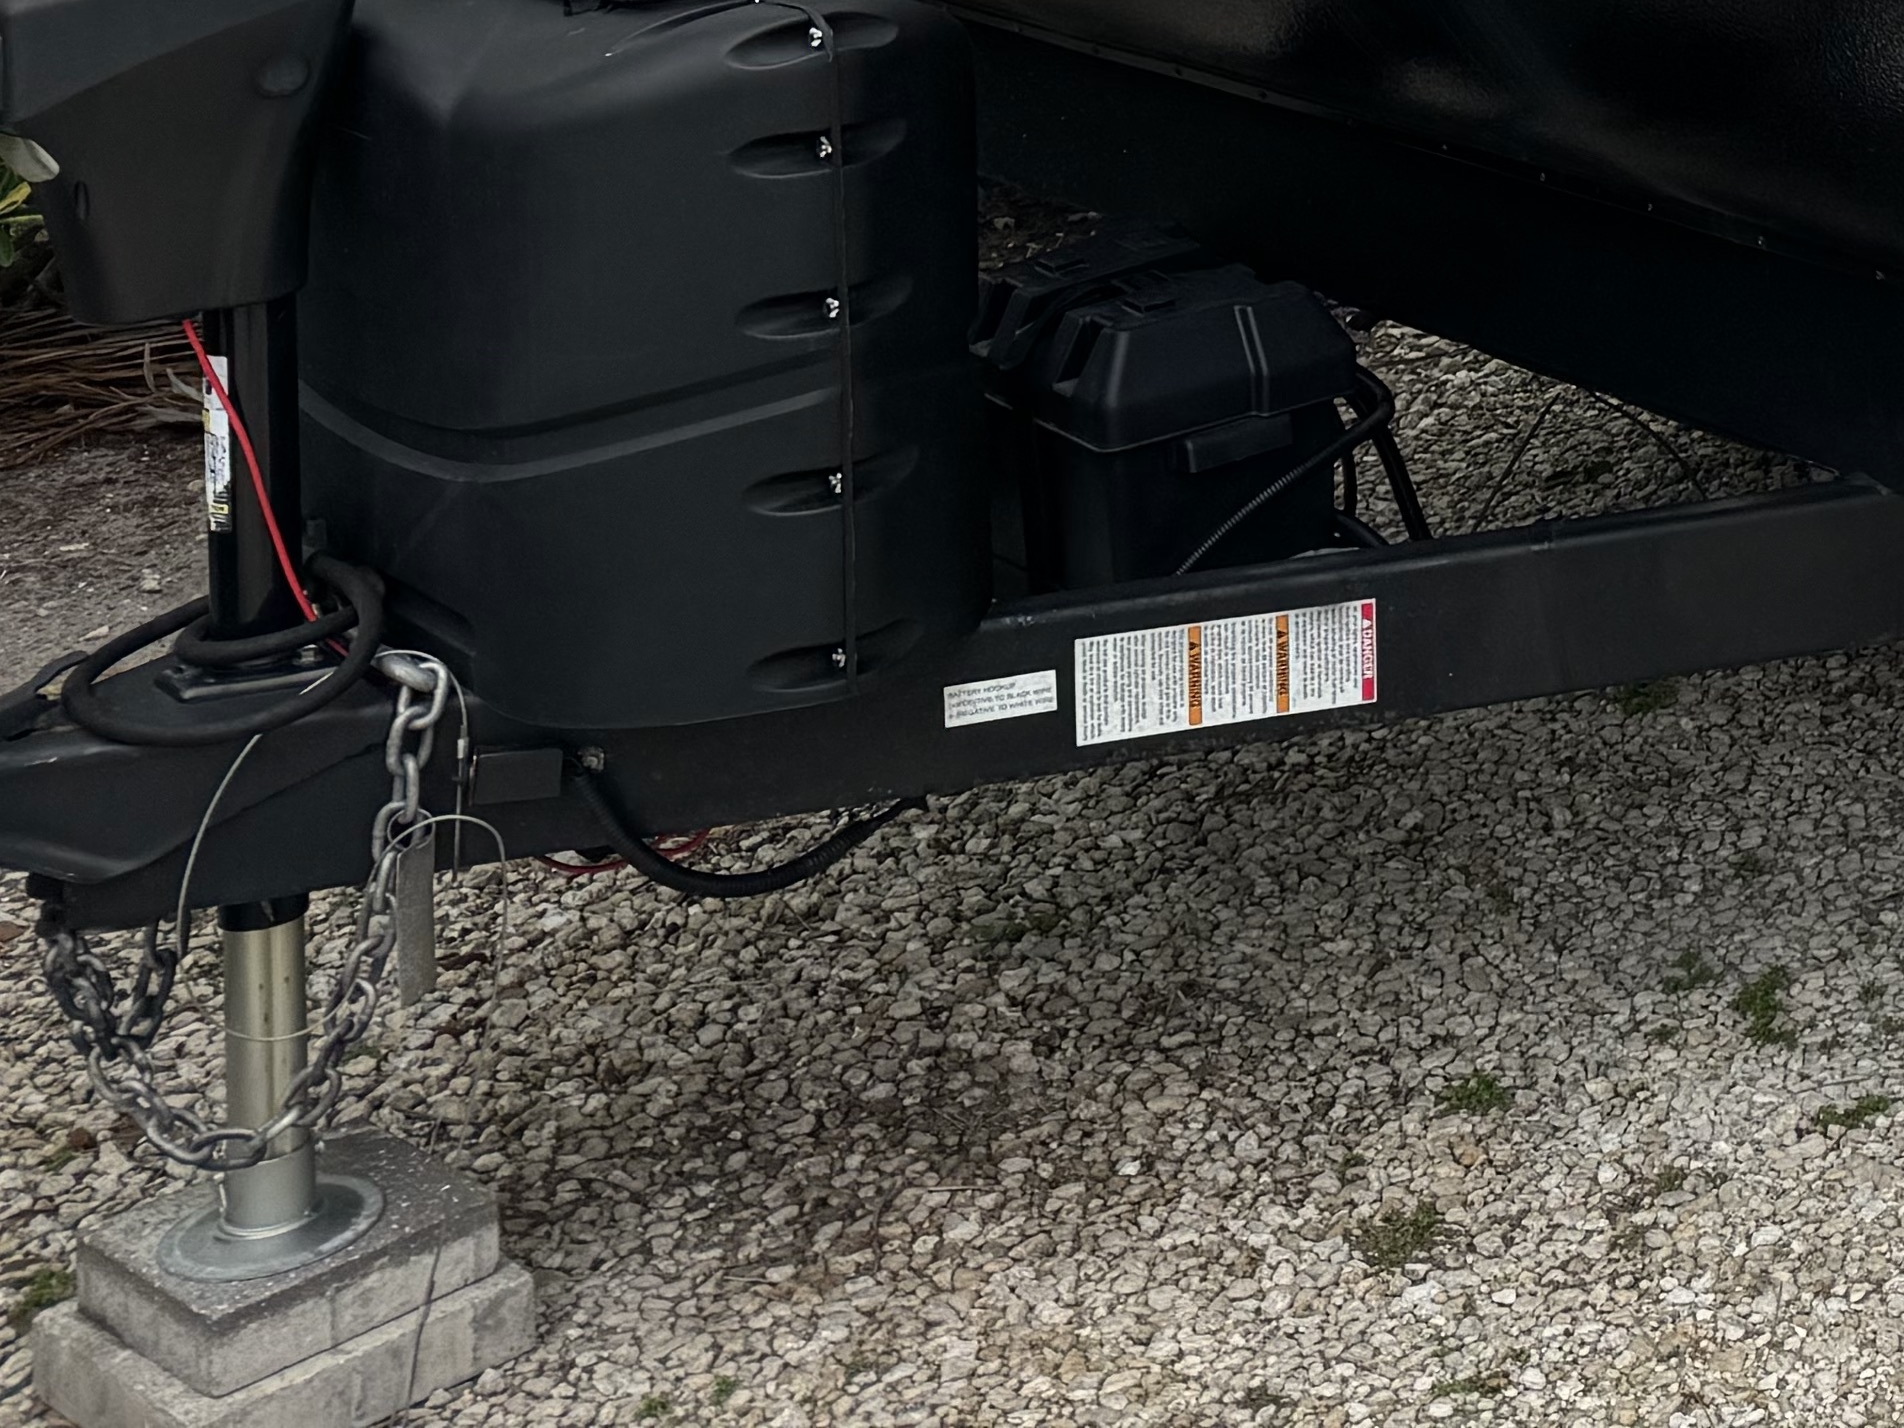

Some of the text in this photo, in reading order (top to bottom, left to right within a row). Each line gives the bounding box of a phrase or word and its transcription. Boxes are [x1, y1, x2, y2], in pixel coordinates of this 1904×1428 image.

[1189, 654, 1202, 708] WARNING
[1277, 640, 1290, 696] WARNING
[1362, 630, 1374, 679] DANGER
